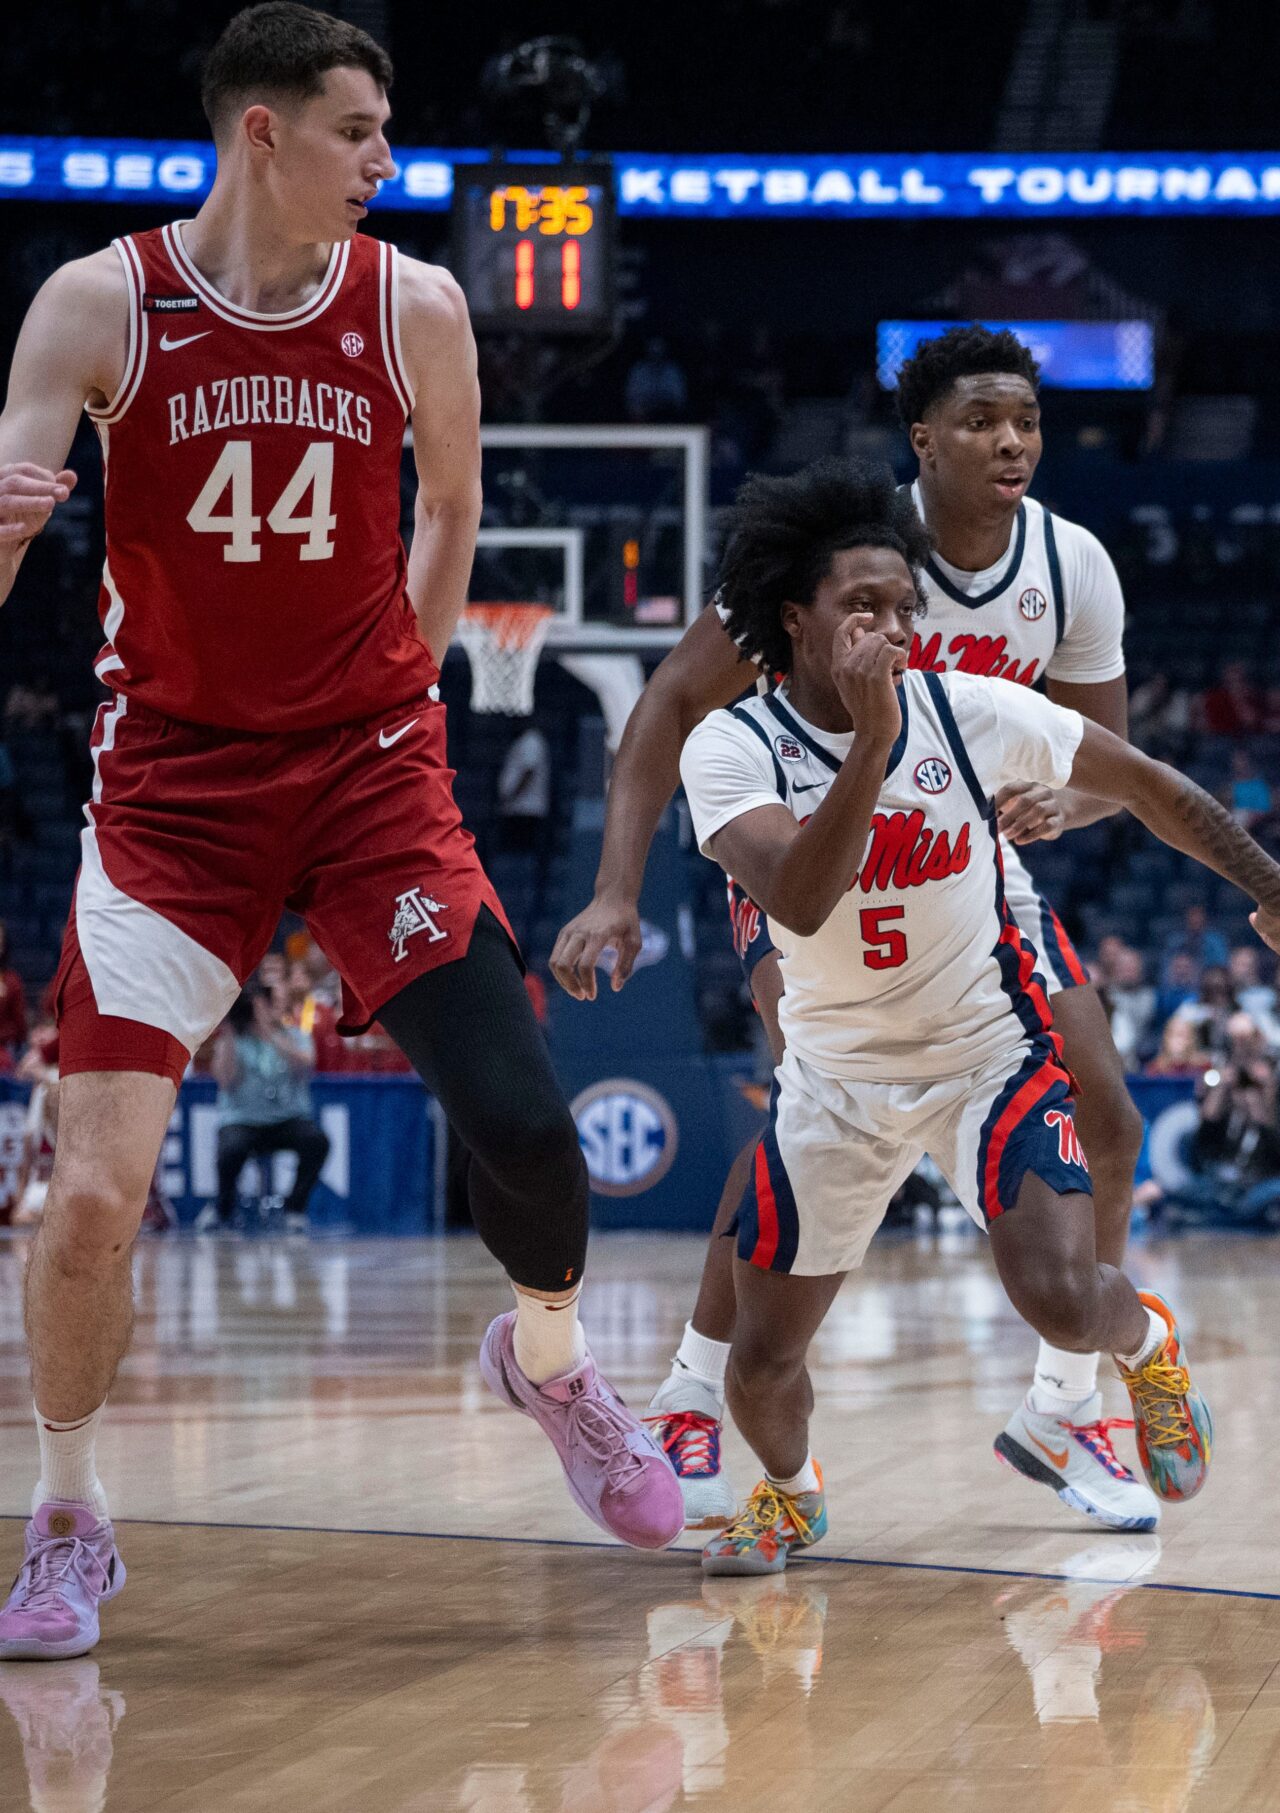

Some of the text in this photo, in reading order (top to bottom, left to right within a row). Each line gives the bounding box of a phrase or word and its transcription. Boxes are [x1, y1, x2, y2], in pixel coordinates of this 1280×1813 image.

[63, 152, 206, 191] SEC
[620, 166, 945, 205] KETBALL
[490, 185, 594, 236] 17:35
[515, 239, 582, 311] 11
[155, 298, 198, 309] TOGETHER
[341, 332, 364, 357] SEC
[168, 375, 372, 446] RAZORBACKS
[186, 440, 337, 563] 44
[1020, 589, 1046, 620] SEC
[780, 743, 802, 759] 22
[914, 758, 952, 794] SEC
[859, 808, 972, 894] Miss
[859, 905, 908, 971] 5
[577, 1092, 662, 1184] SEC
